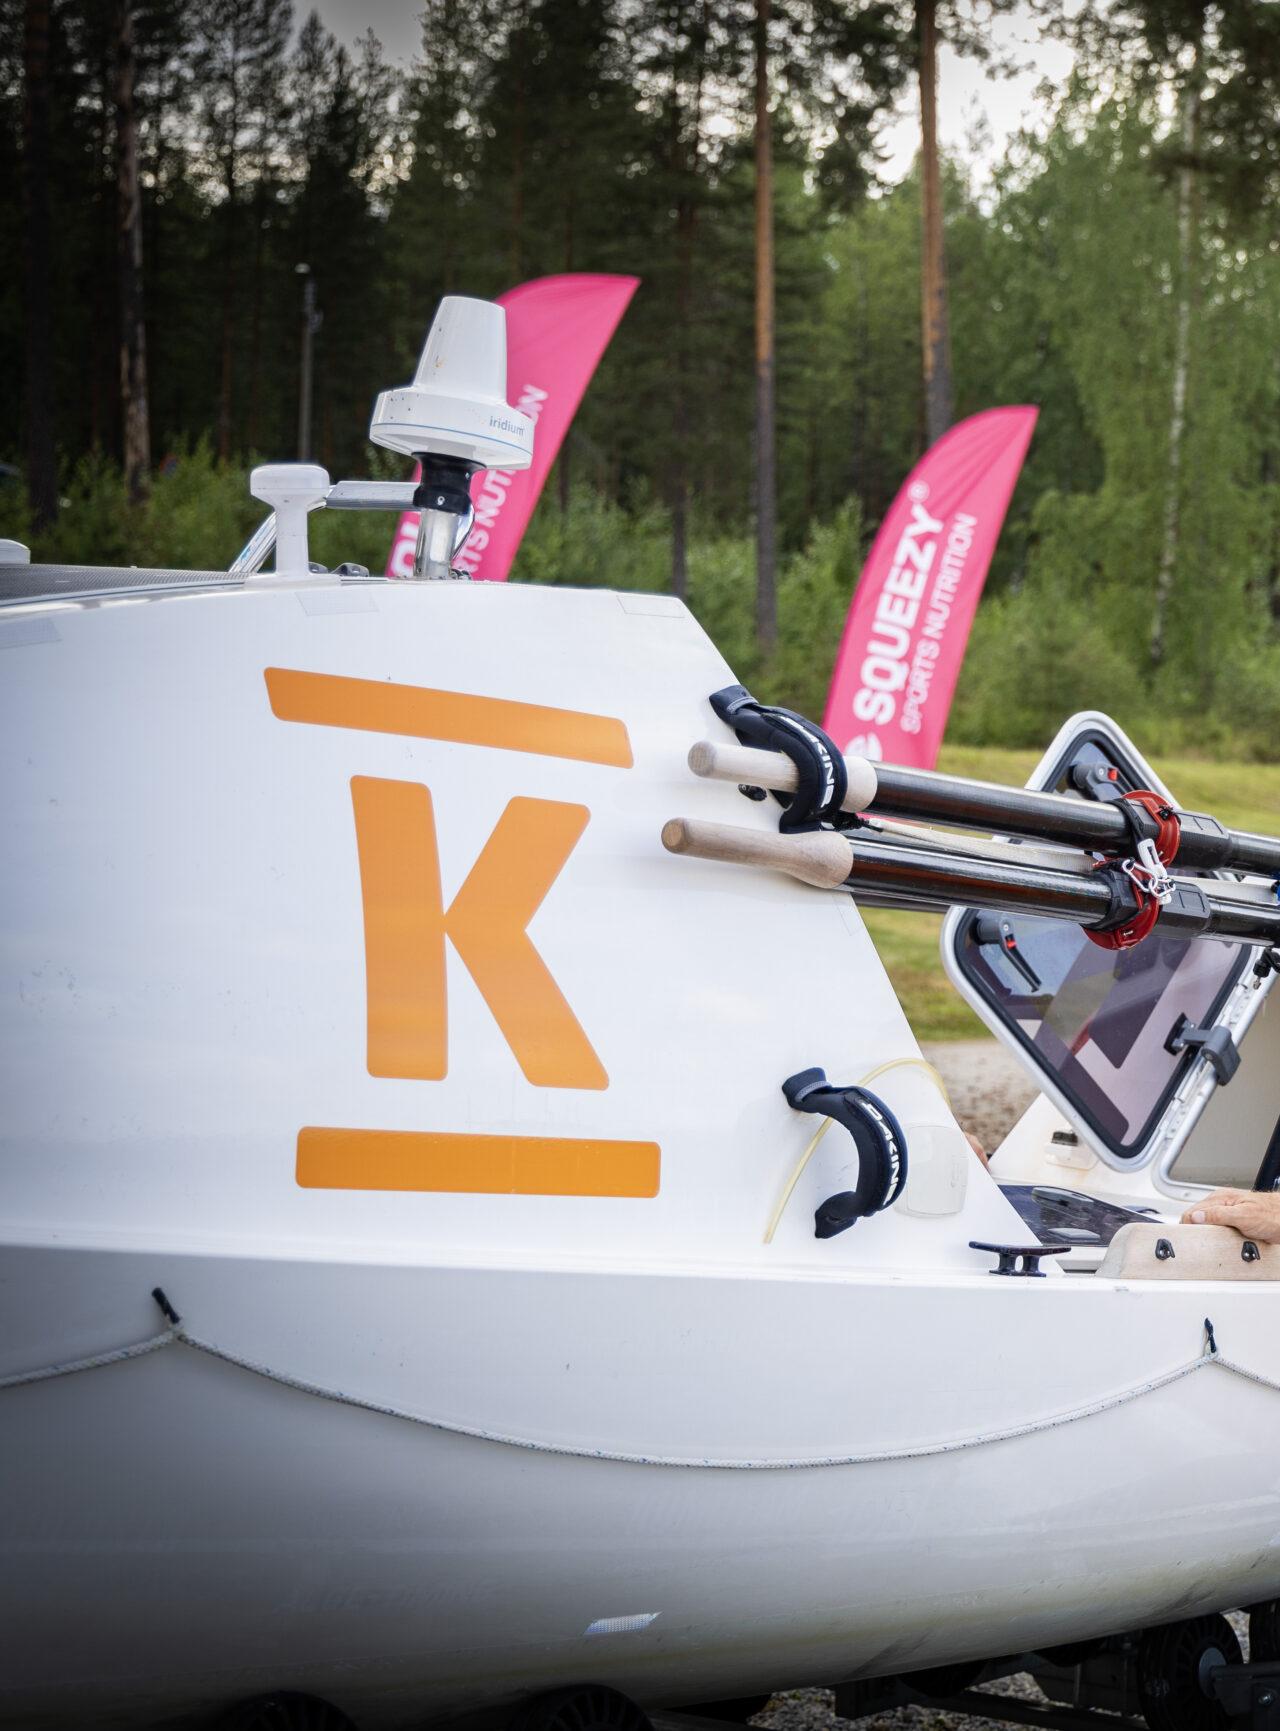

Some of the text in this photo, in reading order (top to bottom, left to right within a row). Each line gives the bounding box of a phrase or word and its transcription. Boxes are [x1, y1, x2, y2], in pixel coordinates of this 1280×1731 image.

[489, 415, 525, 436] iridium
[901, 512, 977, 735] SPORTS NUTRITION
